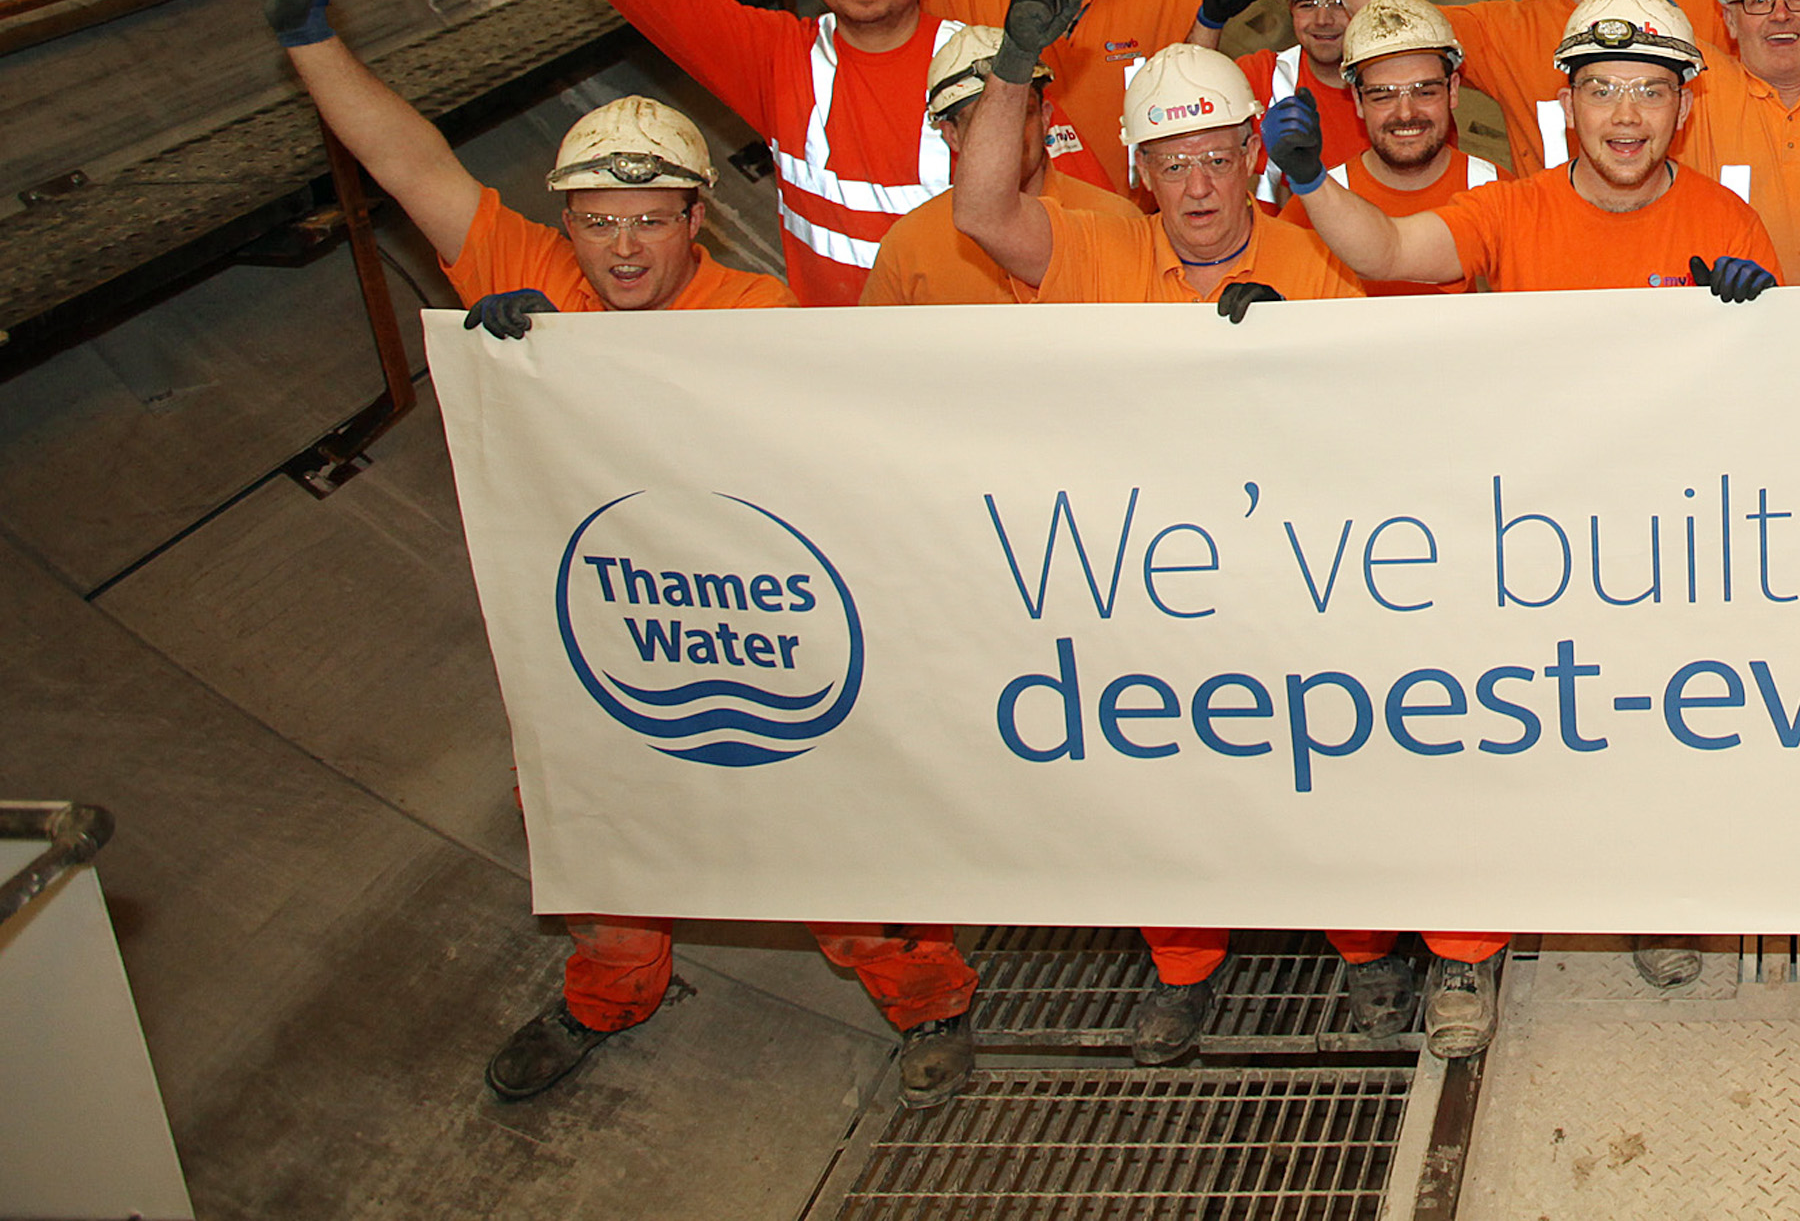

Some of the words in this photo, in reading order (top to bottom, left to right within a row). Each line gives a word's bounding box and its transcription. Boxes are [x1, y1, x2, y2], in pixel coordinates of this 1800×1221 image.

[1166, 97, 1215, 121] mvb
[1493, 473, 1799, 608] built
[582, 555, 817, 613] Thames
[623, 616, 801, 670] Water
